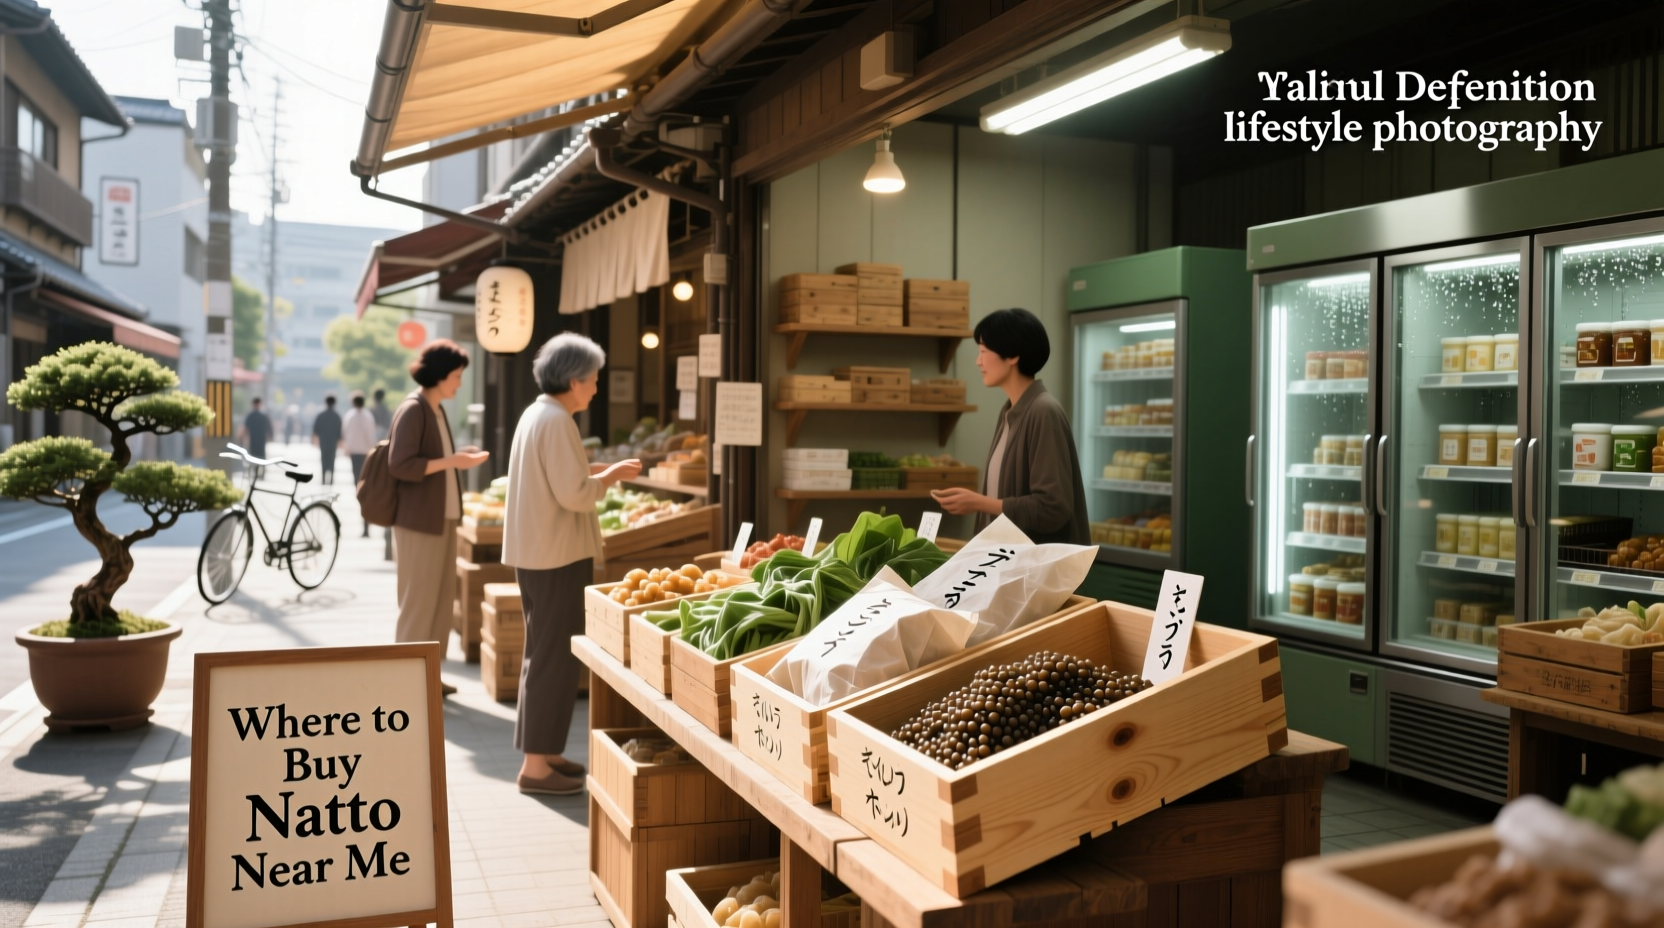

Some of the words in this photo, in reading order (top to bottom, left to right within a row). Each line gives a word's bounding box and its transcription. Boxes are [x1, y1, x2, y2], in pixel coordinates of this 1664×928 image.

[227, 703, 361, 742] Where
[371, 705, 410, 733] to
[282, 747, 362, 790] Buy
[245, 790, 401, 842] Natto
[230, 852, 334, 892] Near
[344, 840, 411, 881] Me
